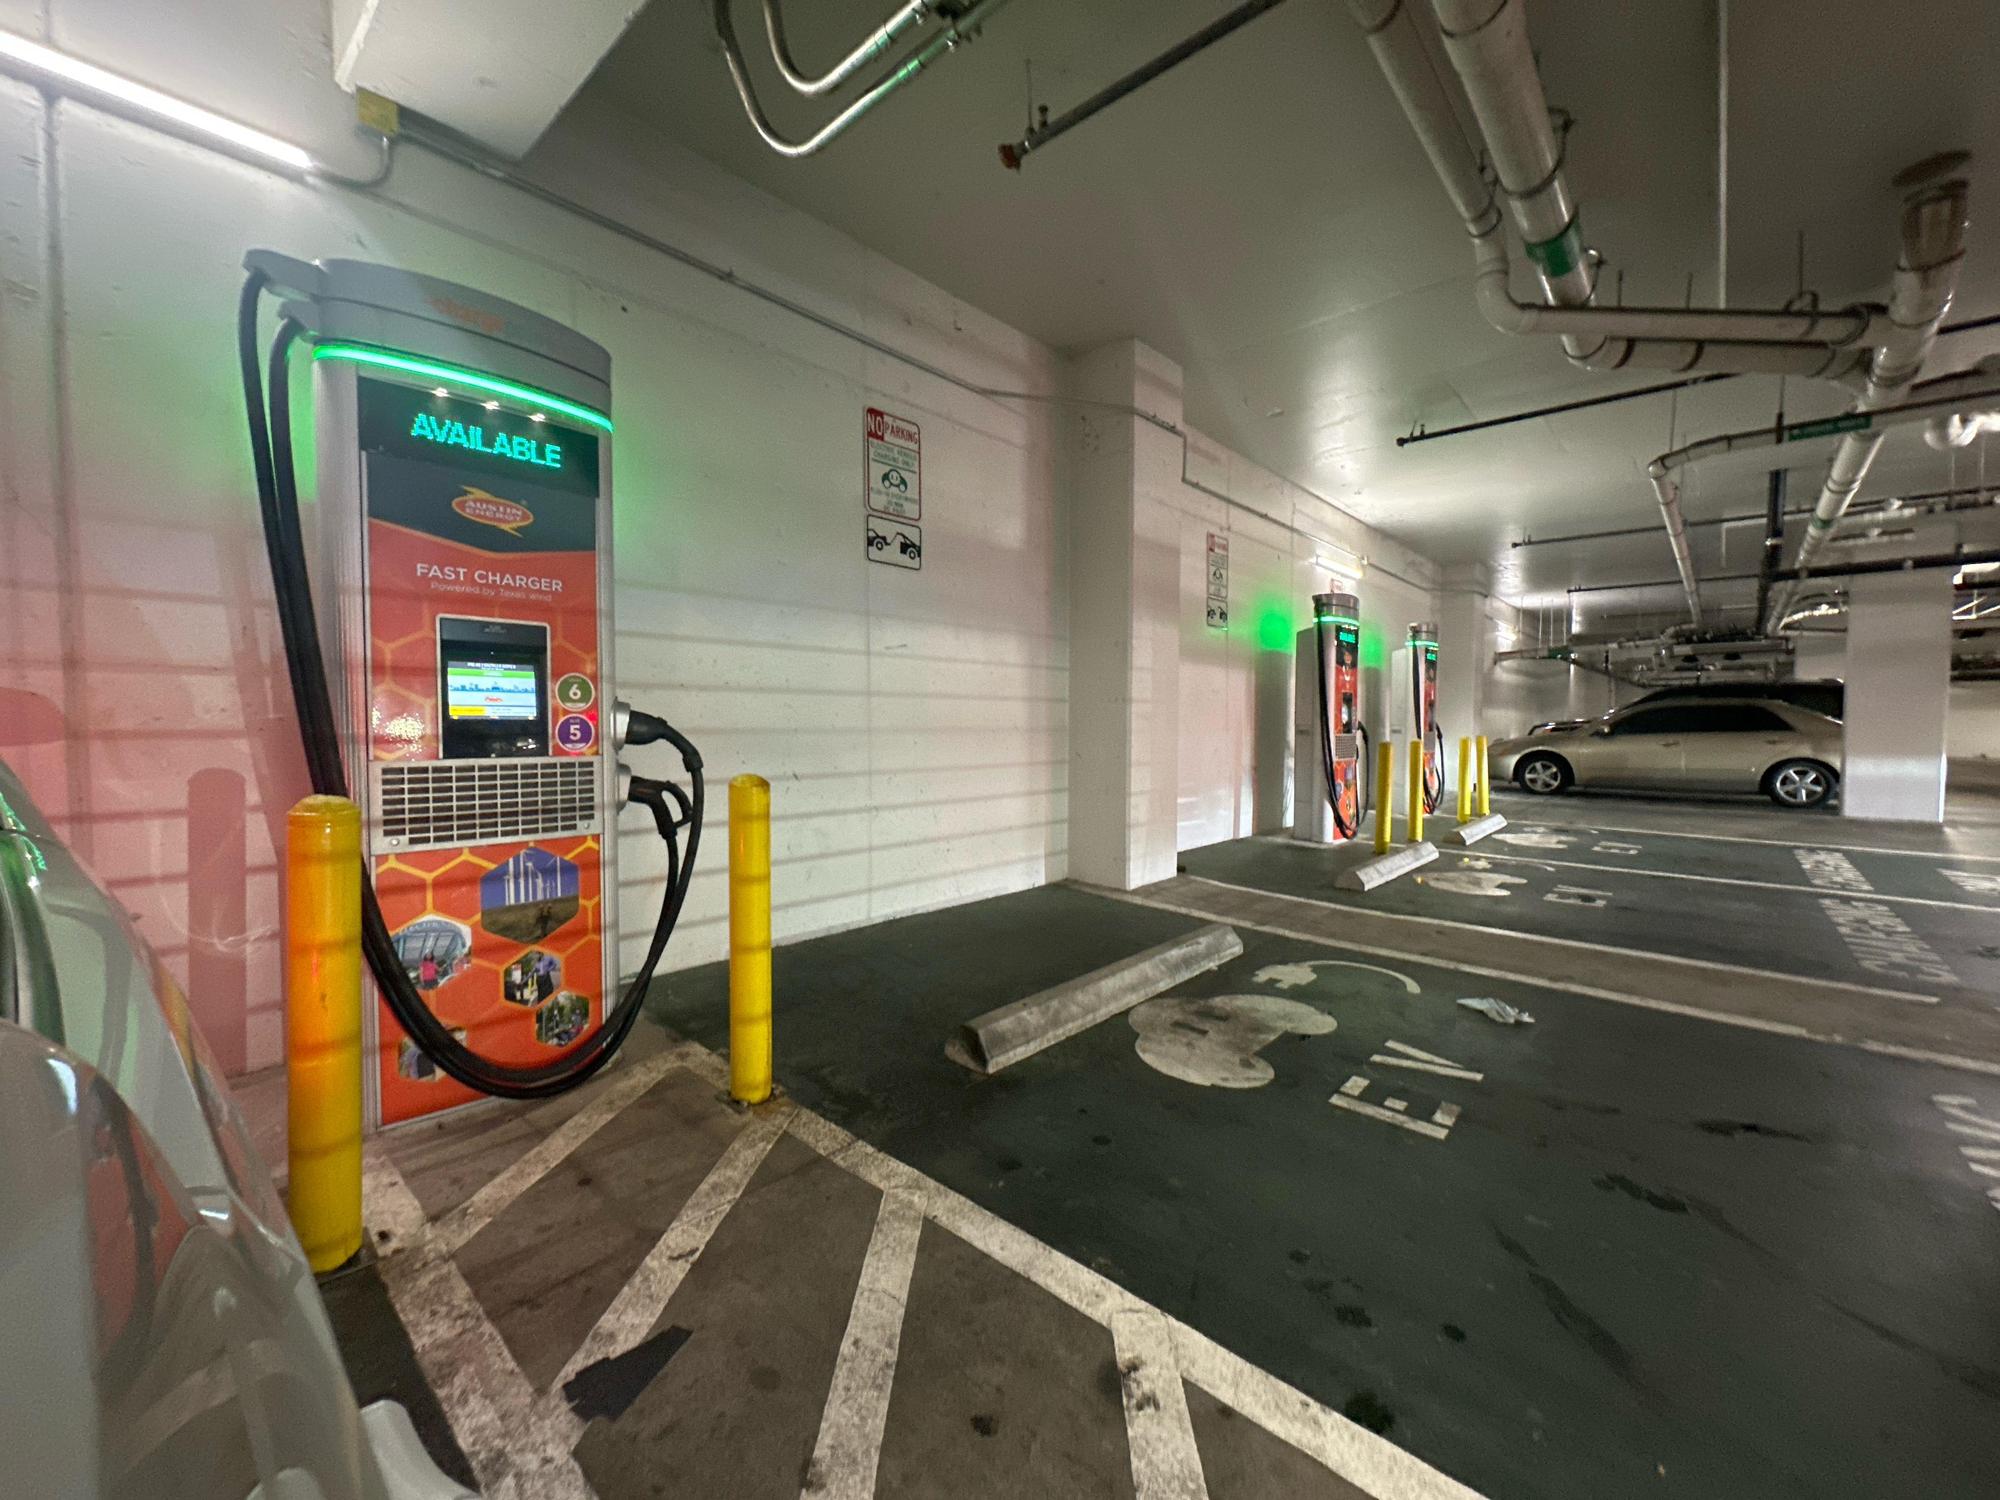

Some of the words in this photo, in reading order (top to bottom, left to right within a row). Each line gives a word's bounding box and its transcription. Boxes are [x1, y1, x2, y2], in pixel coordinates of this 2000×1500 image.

[868, 413, 884, 436] NO
[884, 423, 918, 445] PARKING
[411, 413, 561, 468] AVAILABLE
[465, 500, 522, 517] AUSTIN
[465, 507, 521, 521] ENERGY
[415, 562, 468, 581] FAST
[474, 569, 564, 592] CHARGER
[430, 581, 479, 595] Powered
[482, 587, 496, 597] by
[568, 683, 582, 700] 6
[569, 724, 582, 741] 5
[1329, 1039, 1484, 1140] EV
